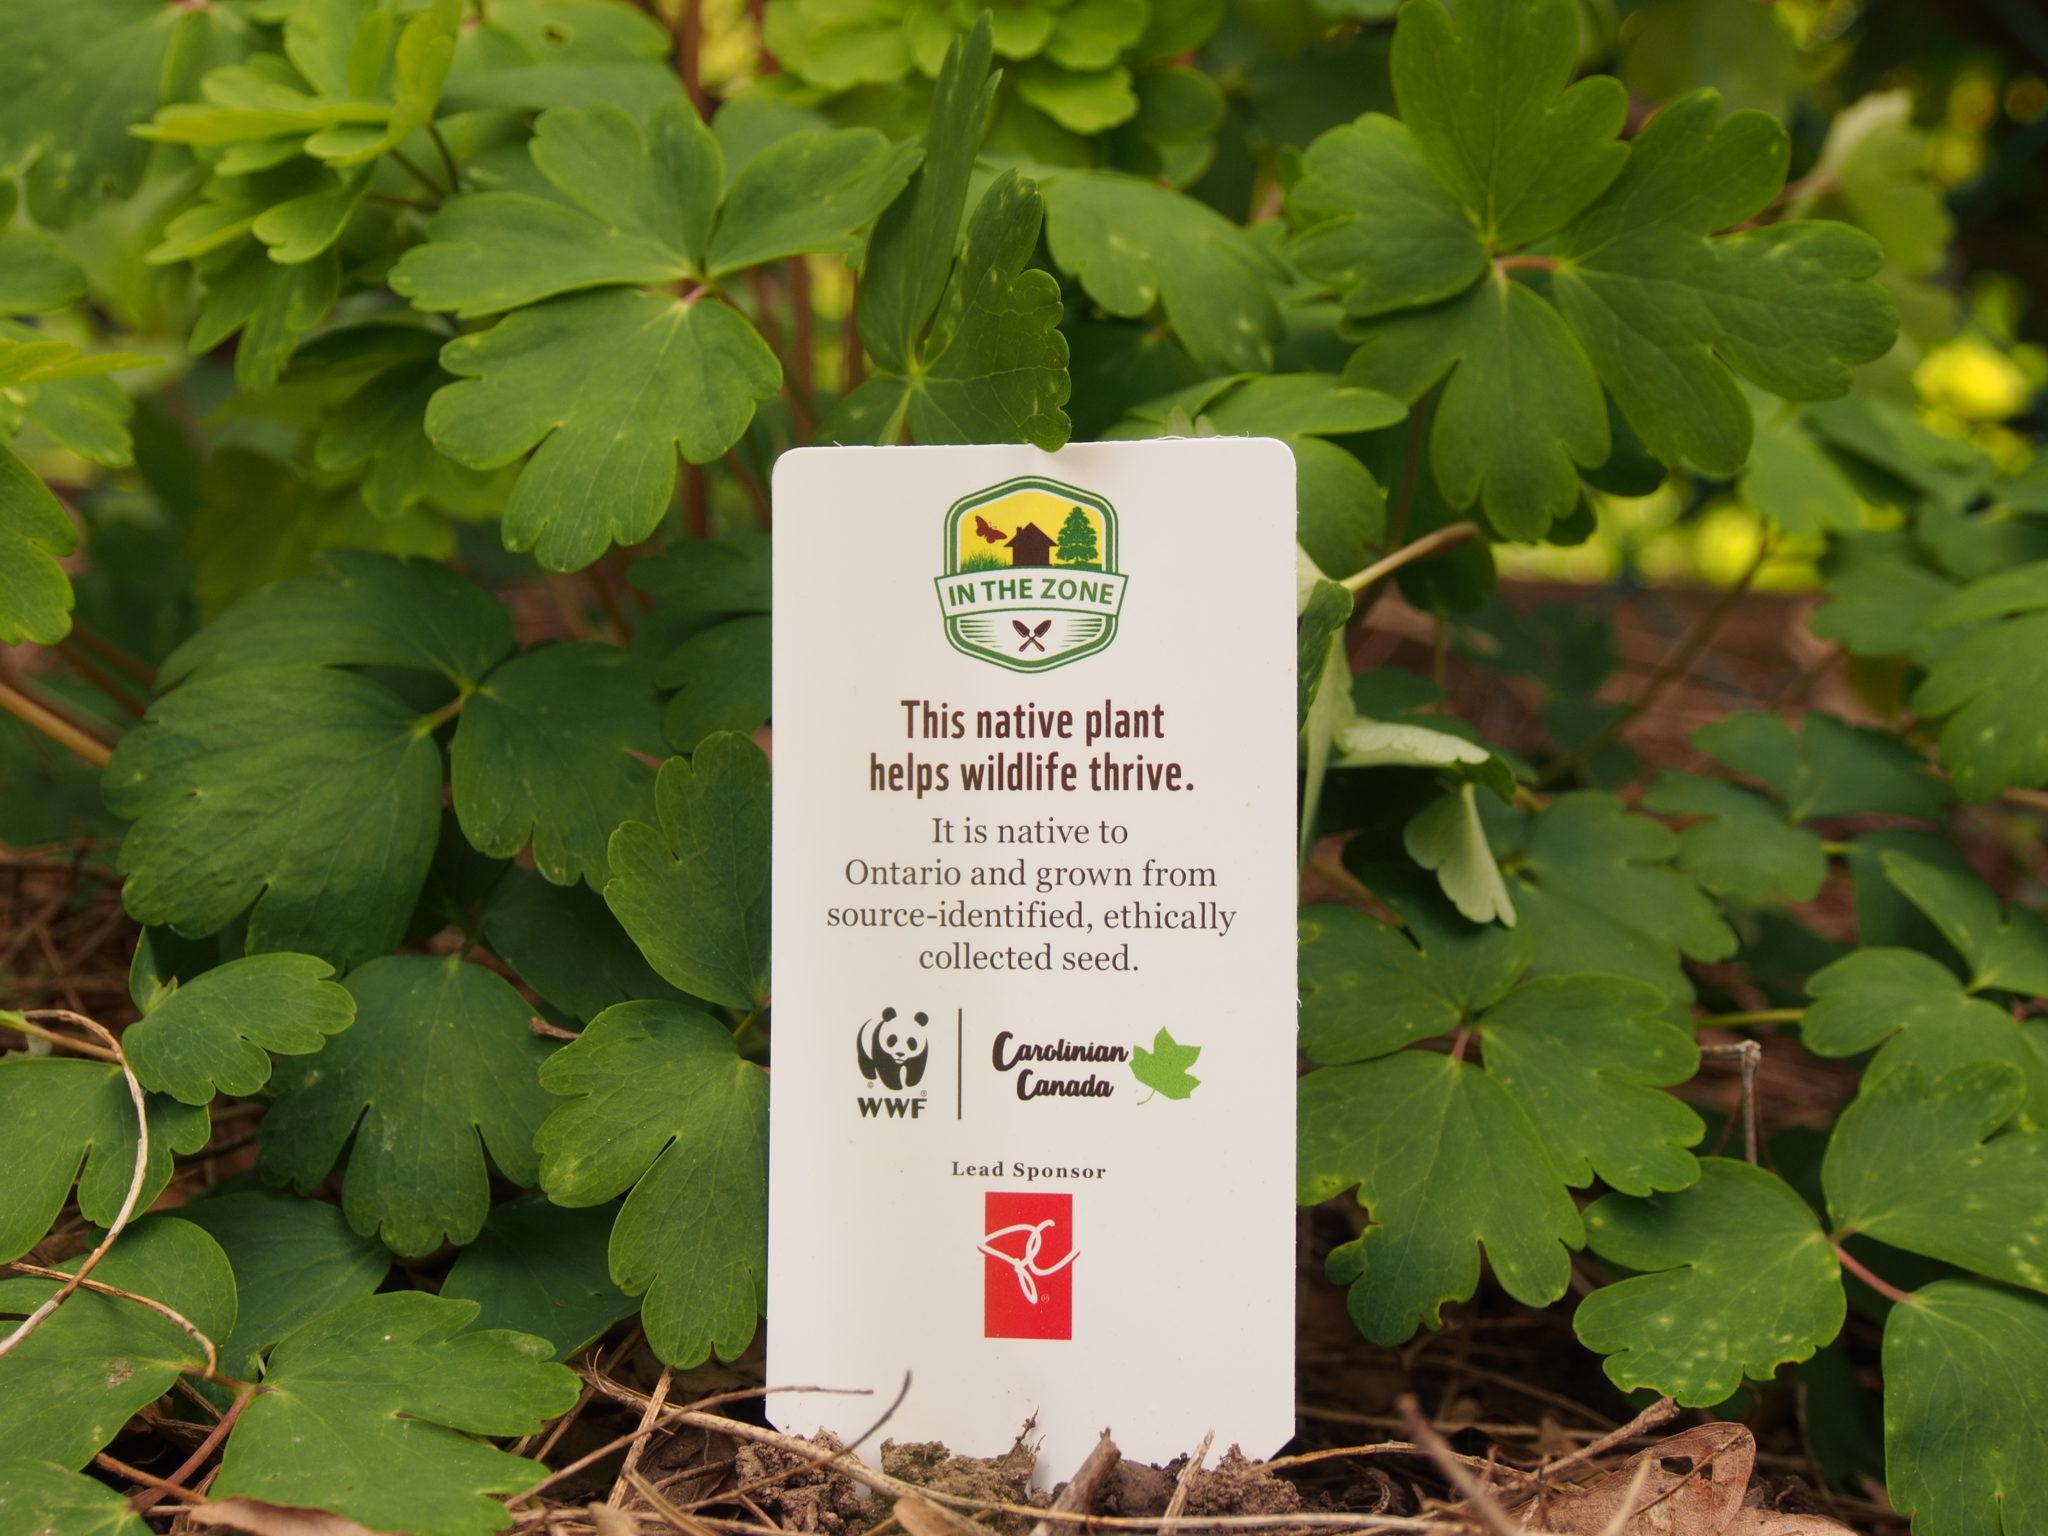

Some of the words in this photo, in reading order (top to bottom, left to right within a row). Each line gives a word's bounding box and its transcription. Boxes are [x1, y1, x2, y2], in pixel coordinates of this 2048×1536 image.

[948, 583, 975, 606] IN
[980, 578, 1033, 601] THE
[1040, 578, 1115, 605] ZONE
[901, 700, 965, 739] This
[977, 702, 1073, 739] native
[1086, 699, 1164, 747] plant
[870, 752, 949, 799] helps
[960, 751, 1076, 791] wildlife
[1089, 752, 1194, 791] thrive.
[932, 818, 954, 843] It
[964, 817, 987, 843] is
[998, 817, 1089, 844] native
[1099, 821, 1128, 844] to
[846, 859, 960, 885] Ontario
[971, 858, 1026, 886] and
[1036, 868, 1132, 893] grown
[1142, 859, 1216, 886] from
[827, 900, 1092, 933] source-identified,
[1104, 901, 1236, 936] ethically
[919, 942, 1053, 970] collected
[1063, 944, 1138, 971] seed.
[992, 1031, 1129, 1072] Carolinian
[1017, 1068, 1114, 1101] Canada
[857, 1097, 927, 1119] WWF
[952, 1161, 1003, 1176] Lead
[1013, 1163, 1106, 1181] Sponsor
